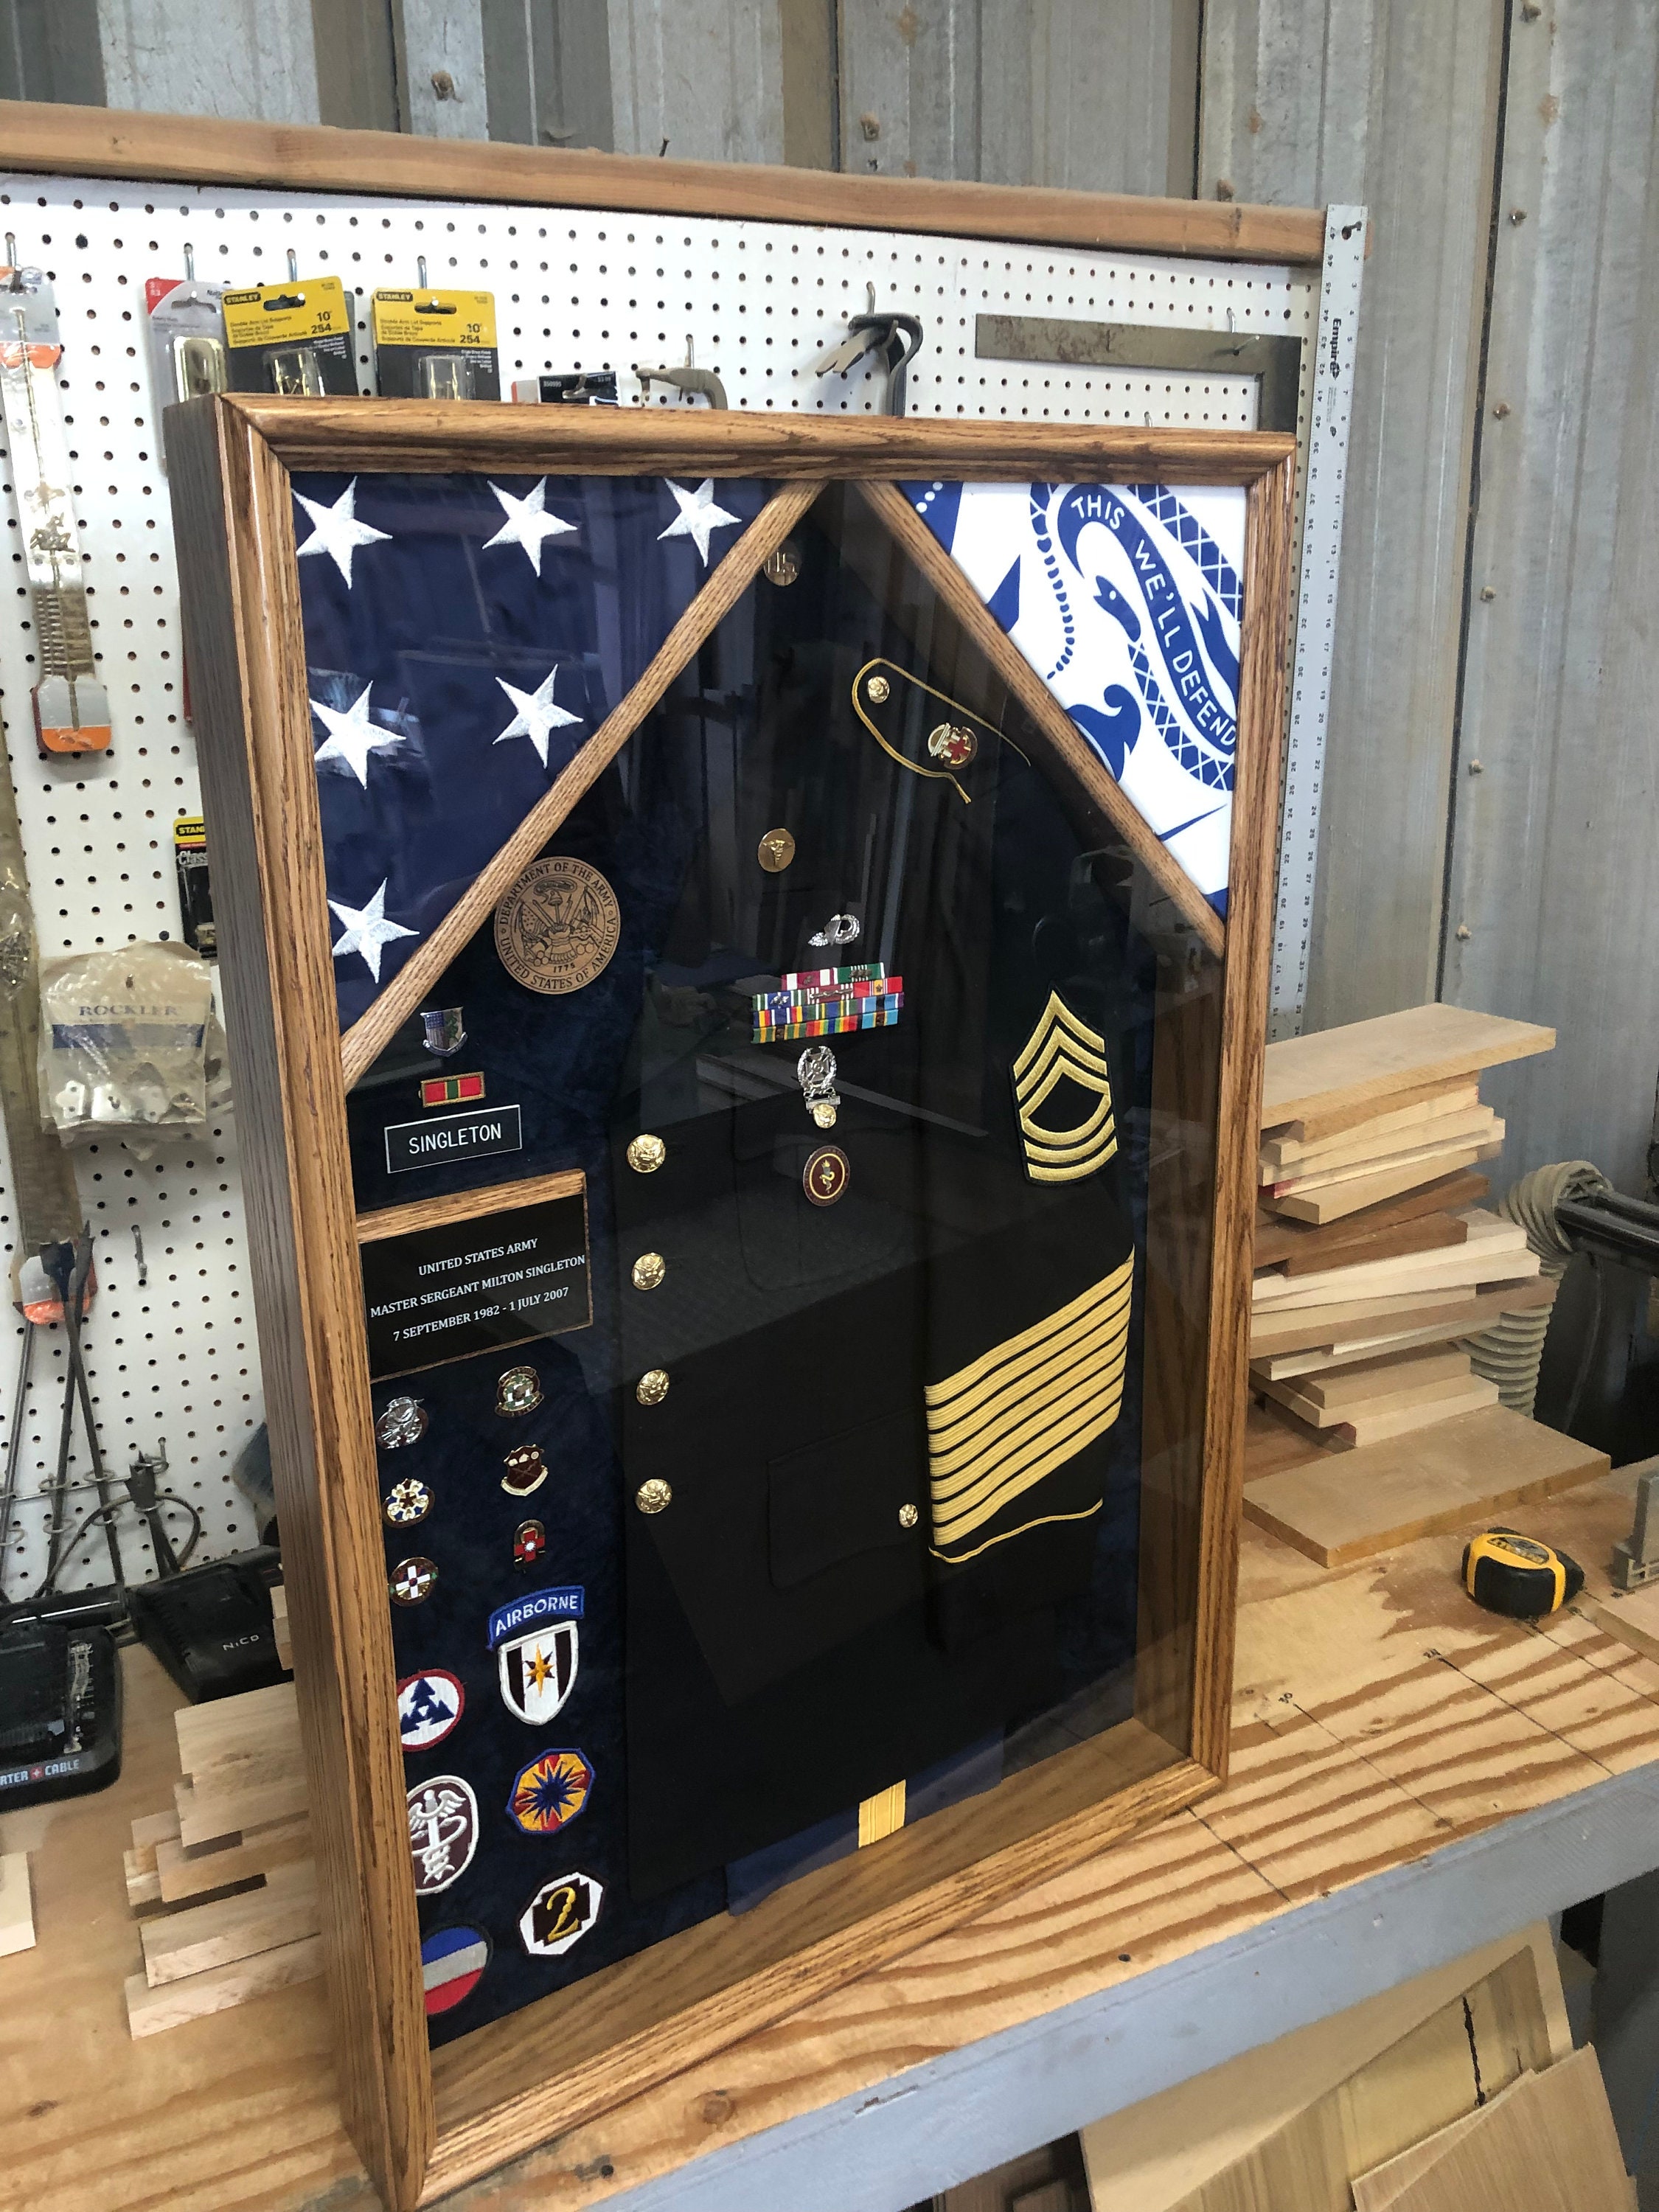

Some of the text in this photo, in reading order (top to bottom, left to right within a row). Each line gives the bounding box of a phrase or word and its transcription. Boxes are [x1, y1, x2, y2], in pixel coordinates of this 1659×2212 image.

[226, 294, 257, 304] STANLEY
[1321, 336, 1326, 348] 43
[1320, 364, 1325, 375] 42
[1318, 391, 1323, 402] 41
[1315, 416, 1321, 428] 40
[1314, 442, 1319, 453] 39
[1312, 468, 1317, 479] 38
[1337, 470, 1342, 479] 10
[1310, 494, 1315, 504] 37
[1335, 495, 1340, 504] 11
[1308, 519, 1313, 529] 36
[1333, 520, 1338, 529] 12
[1307, 544, 1312, 554] 35
[1332, 545, 1336, 554] 13
[1305, 569, 1310, 579] 34
[1329, 569, 1335, 579] 14
[1304, 594, 1308, 604] 33
[1327, 594, 1332, 603] 15
[1071, 495, 1237, 746] THIS WE'LL DEFEND
[1301, 618, 1307, 628] 32
[1326, 619, 1331, 627] 16
[1300, 643, 1305, 653] 31
[1324, 643, 1329, 652] 17
[1298, 667, 1304, 677] 30
[1322, 667, 1327, 676] 18
[1296, 691, 1301, 700] 29
[1321, 690, 1325, 700] 19
[1295, 714, 1300, 725] 28
[1318, 714, 1324, 723] 20
[1293, 739, 1298, 748] 27
[1317, 737, 1321, 745] 21
[1291, 762, 1296, 771] 26
[1315, 760, 1320, 770] 22
[1290, 785, 1295, 795] 25
[1313, 783, 1318, 793] 23
[1288, 808, 1293, 818] 24
[1312, 806, 1316, 815] 24
[1286, 831, 1291, 841] 23
[1310, 829, 1315, 838] 25
[1284, 854, 1290, 863] 22
[1308, 852, 1313, 861] 26
[1283, 877, 1288, 886] 21
[1306, 874, 1311, 883] 27
[500, 863, 613, 925] DEPARTMENT OF THE ARMY
[1281, 898, 1287, 908] 20
[1304, 896, 1310, 905] 28
[1279, 921, 1284, 929] 19
[1303, 919, 1308, 928] 29
[1278, 942, 1283, 951] 18
[1301, 940, 1306, 950] 30
[501, 918, 616, 989] UNITED STATES OF AMERICA
[554, 963, 575, 973] 1775
[1276, 965, 1281, 973] 17
[1299, 961, 1304, 970] 31
[1275, 986, 1280, 995] 16
[1298, 983, 1303, 992] 32
[1273, 1008, 1278, 1016] 15
[1296, 1005, 1301, 1014] 33
[1272, 1029, 1276, 1037] 14
[1295, 1026, 1300, 1034] 34
[409, 1123, 501, 1155] SINGLETON
[419, 1238, 538, 1276] UNITED STATES ARMY
[370, 1255, 585, 1318] MASTER SERGEANT MILTON SINGLETON
[393, 1331, 400, 1341] 7
[403, 1313, 470, 1339] SEPTEMBER
[474, 1306, 500, 1321] 1982
[510, 1301, 515, 1311] 1
[518, 1295, 541, 1311] JULY
[544, 1287, 569, 1302] 2007
[496, 1596, 578, 1637] AIRBORNE
[45, 1759, 79, 1775] CABLE
[546, 1887, 579, 1941] 2
